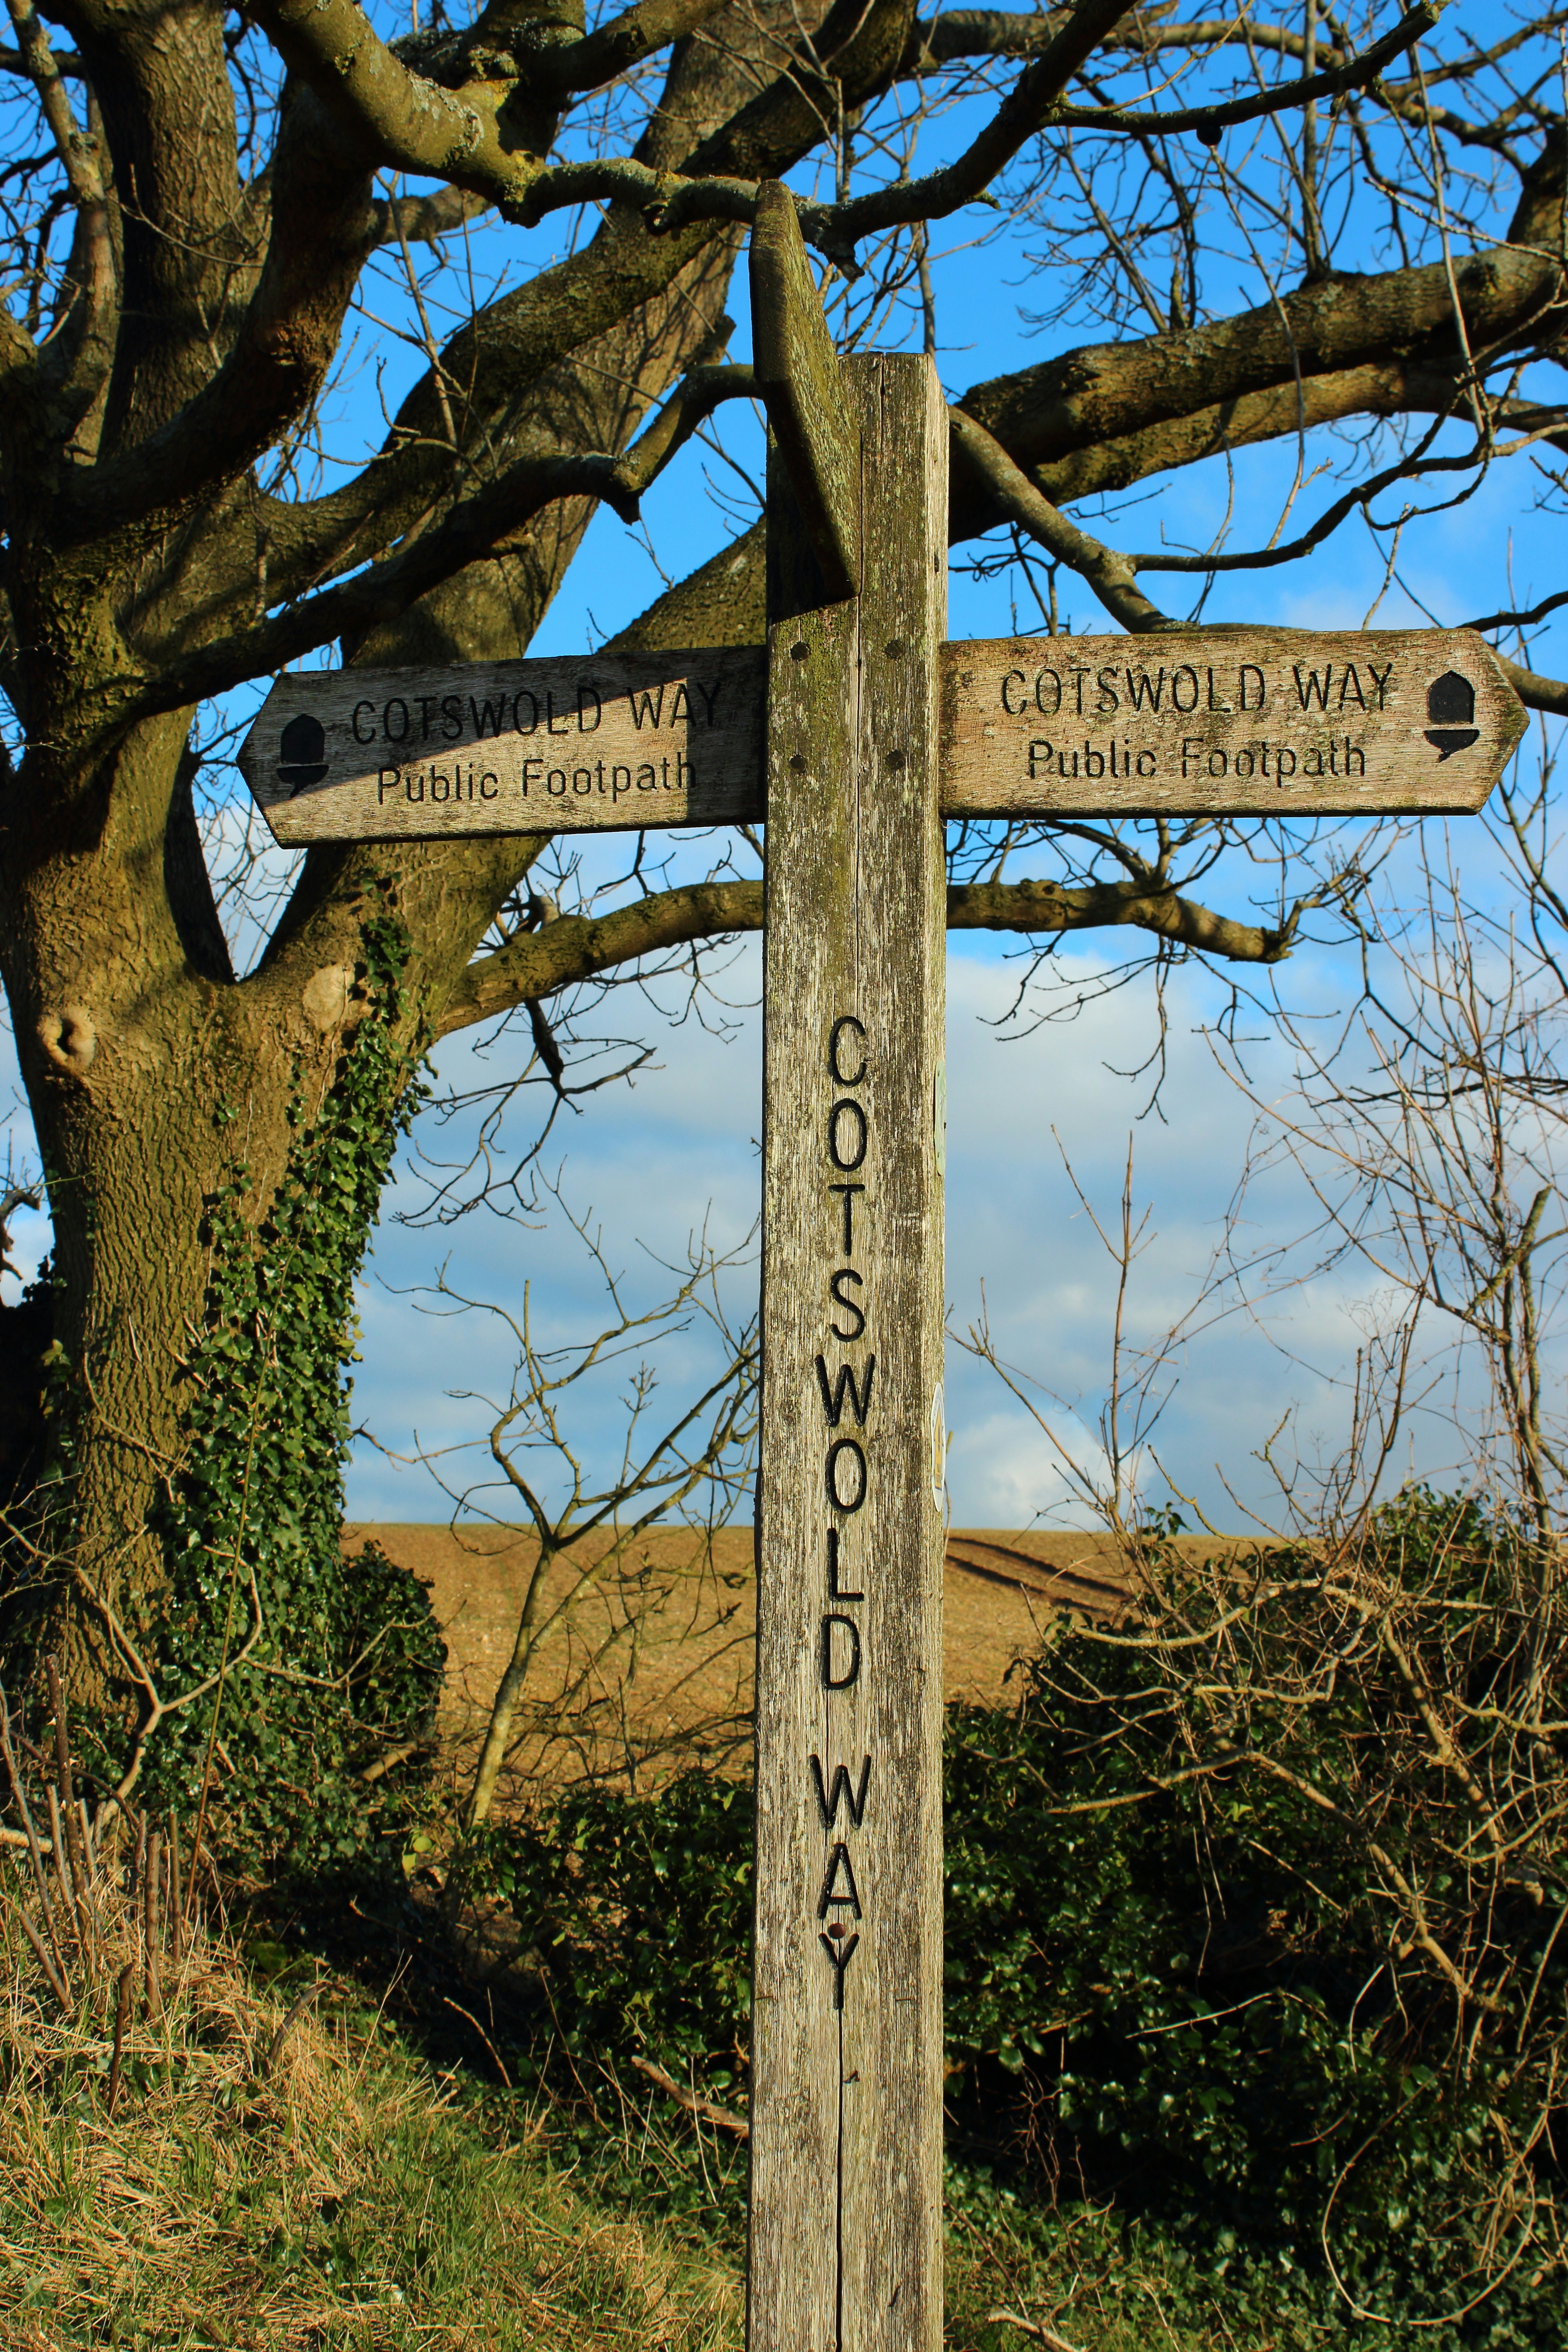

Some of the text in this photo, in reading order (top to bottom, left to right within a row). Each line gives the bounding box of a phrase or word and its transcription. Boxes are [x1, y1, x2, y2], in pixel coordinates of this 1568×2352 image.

[352, 681, 721, 745] COTSWOLD WAY
[1001, 663, 1394, 716] COTSWOLD WAY
[378, 752, 696, 804] Public Footpath
[1028, 737, 1365, 788] Public Footpath
[809, 1015, 876, 2009] COTSWOLD WAY
